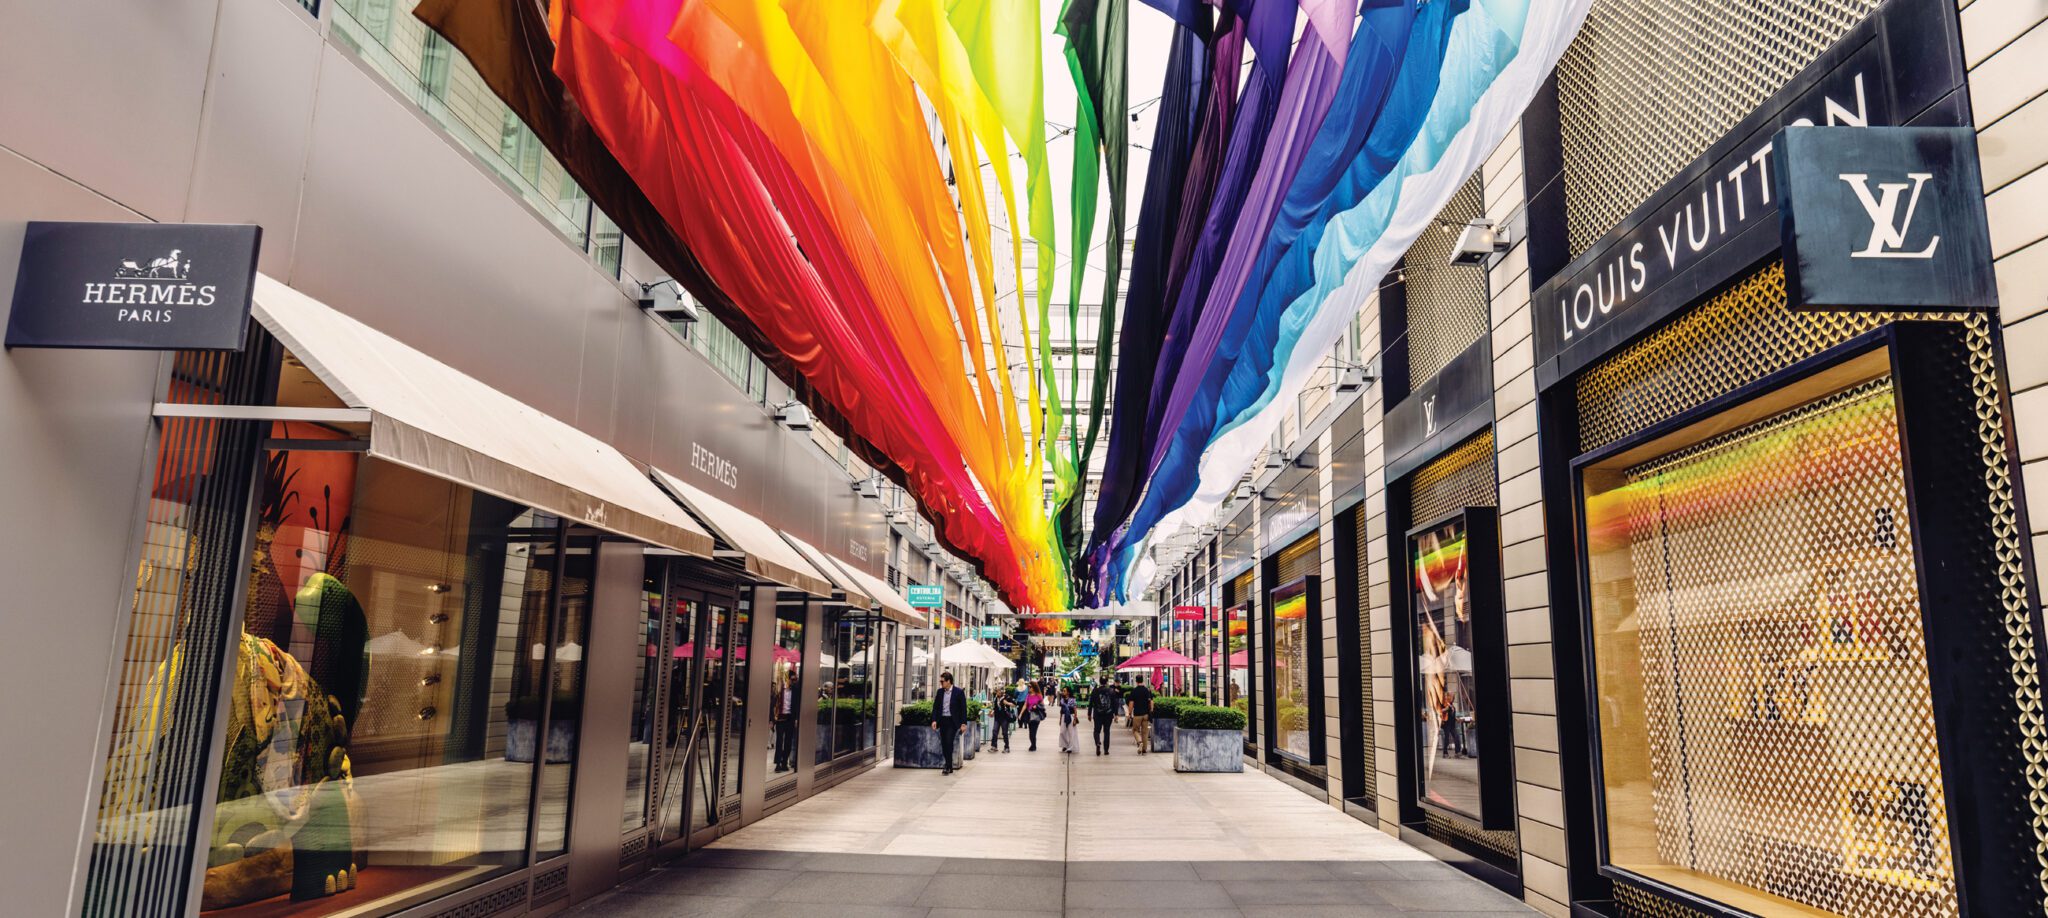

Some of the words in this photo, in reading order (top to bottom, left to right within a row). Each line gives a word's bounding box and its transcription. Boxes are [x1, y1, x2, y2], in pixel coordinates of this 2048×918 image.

[1562, 242, 1647, 340] LOUIS
[1658, 72, 1868, 270] VUITTN
[1838, 173, 1940, 259] LV
[118, 309, 172, 322] PARIS
[1423, 394, 1437, 438] LV
